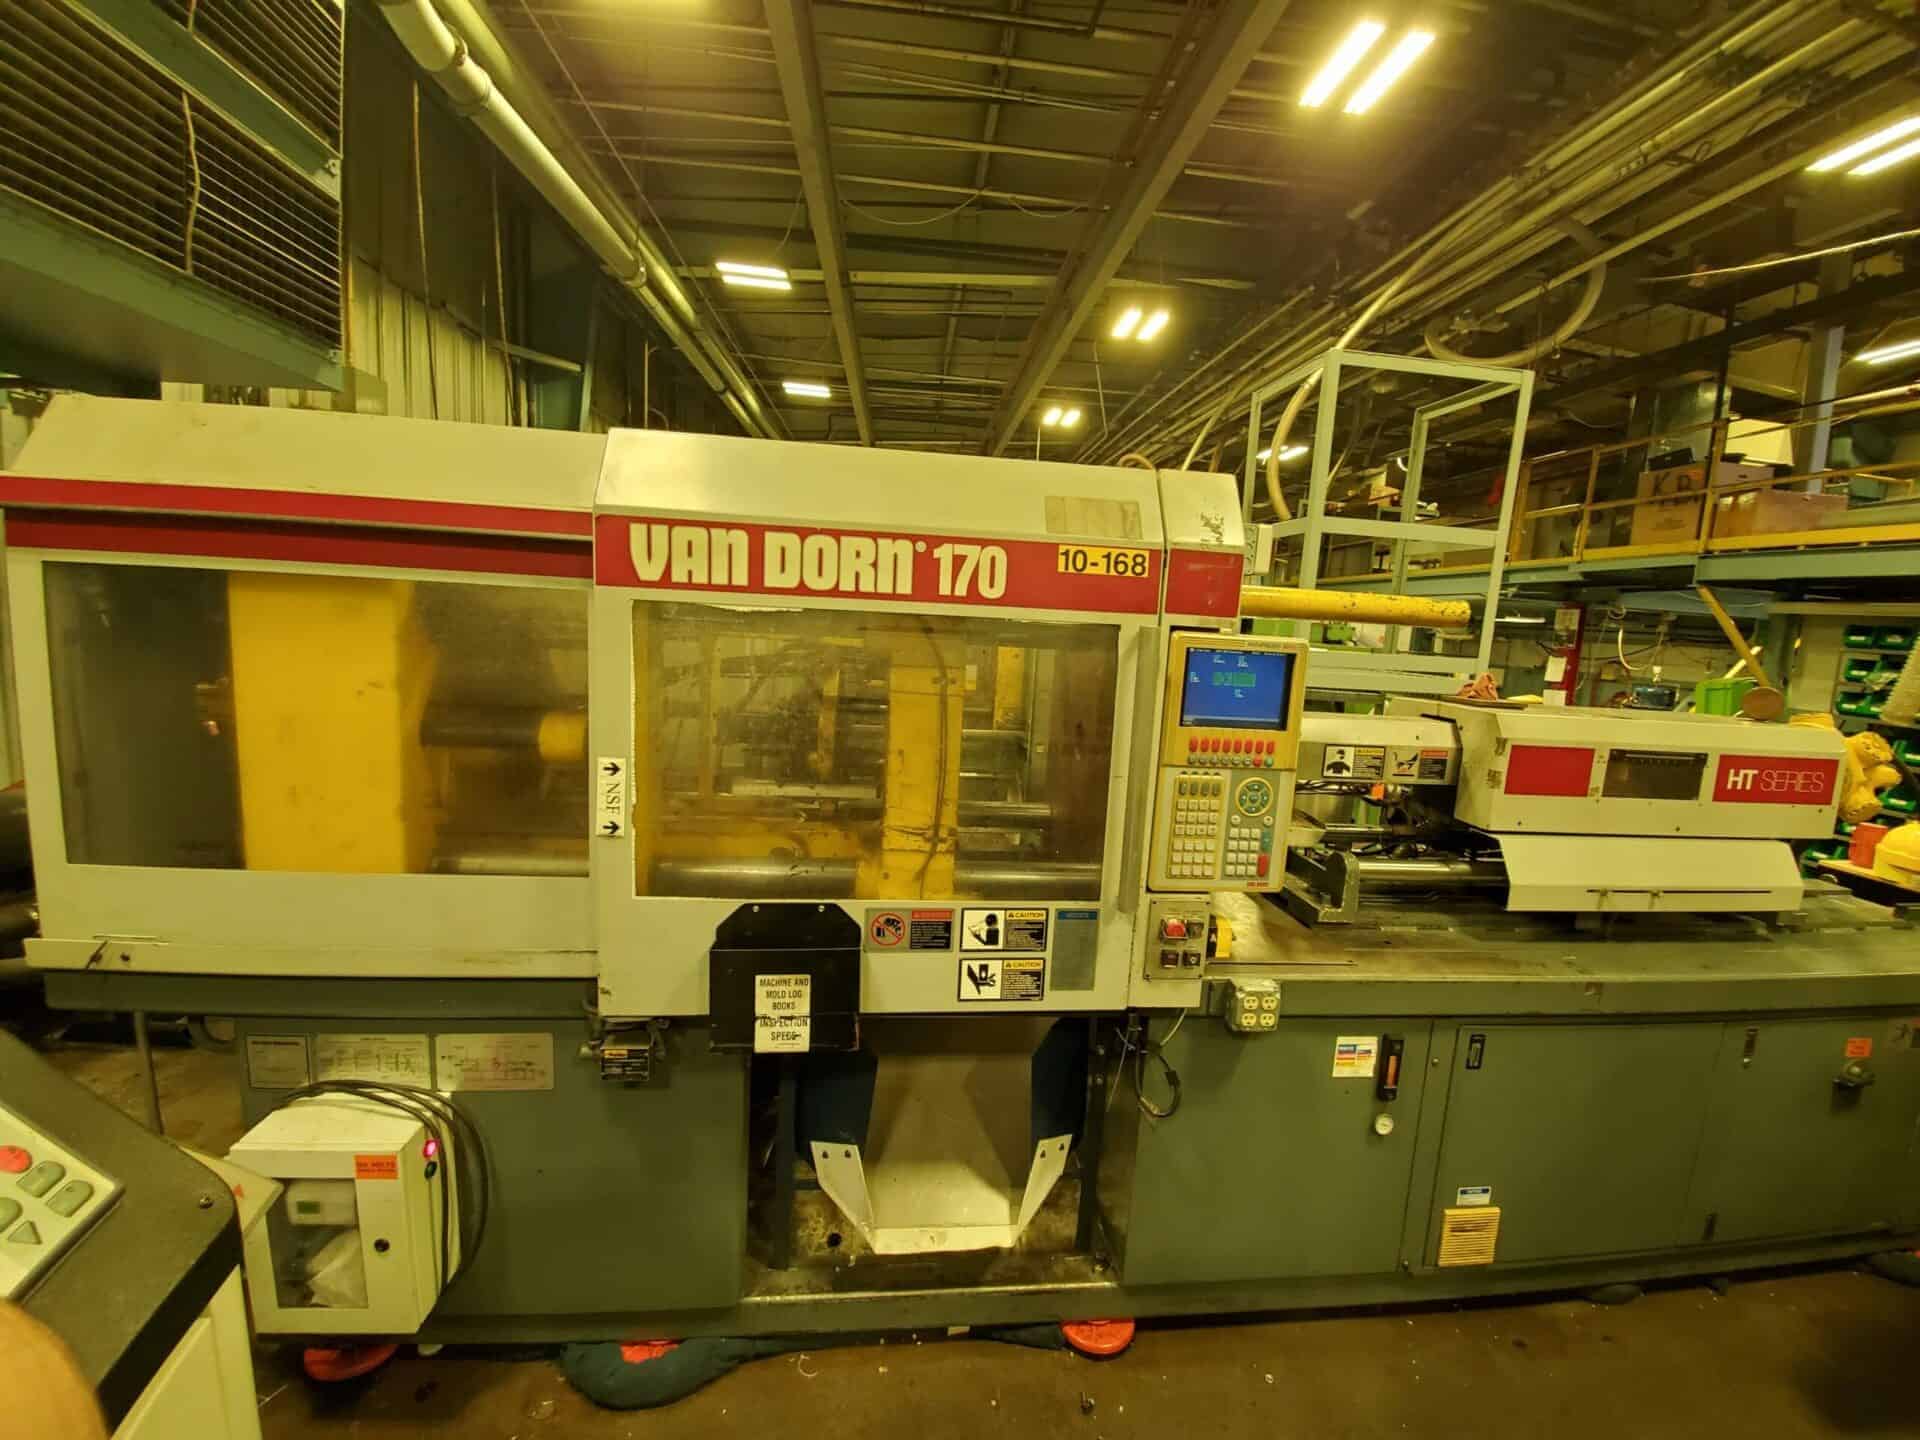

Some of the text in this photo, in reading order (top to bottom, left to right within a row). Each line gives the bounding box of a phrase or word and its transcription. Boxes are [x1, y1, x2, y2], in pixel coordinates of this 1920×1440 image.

[629, 522, 749, 587] VAN
[932, 542, 1008, 600] 170
[1059, 549, 1147, 576] 10-168
[1727, 767, 1825, 793] HT SERIES
[1014, 911, 1044, 919] CAUTION
[760, 977, 793, 987] MACHINE
[766, 990, 802, 999] MOLD LOG
